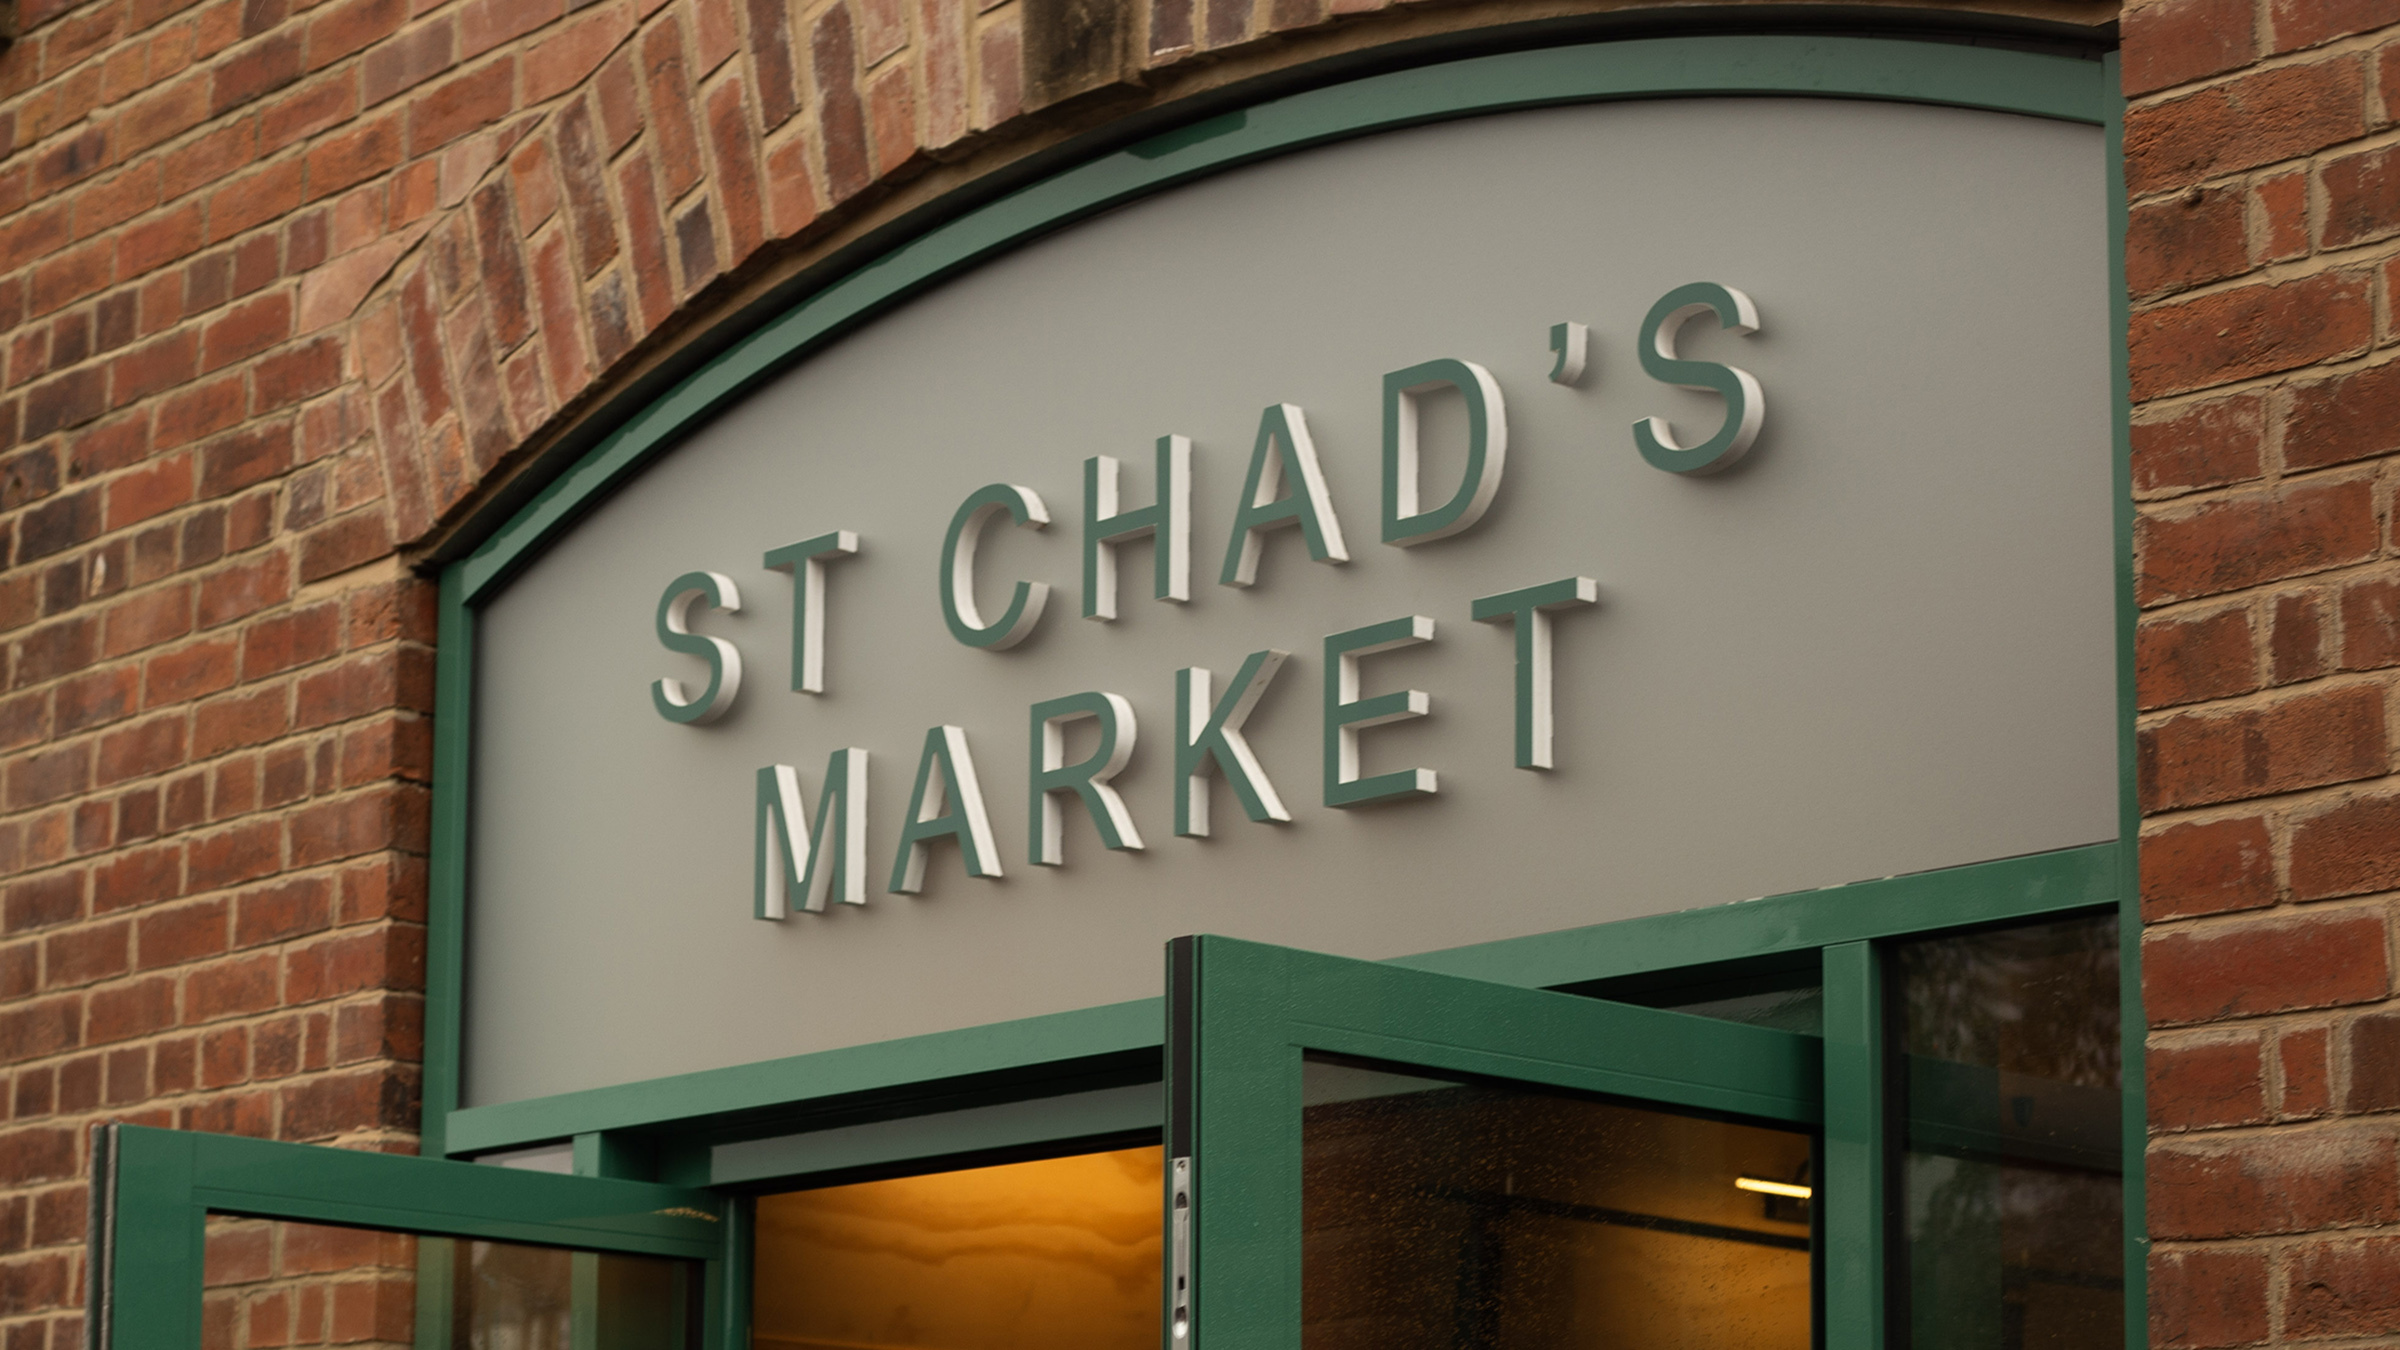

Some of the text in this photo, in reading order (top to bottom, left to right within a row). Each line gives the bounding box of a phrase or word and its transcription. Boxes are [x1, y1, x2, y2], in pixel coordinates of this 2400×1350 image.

[651, 281, 1766, 724] ST CHAD'S
[753, 576, 1598, 921] MARKET
